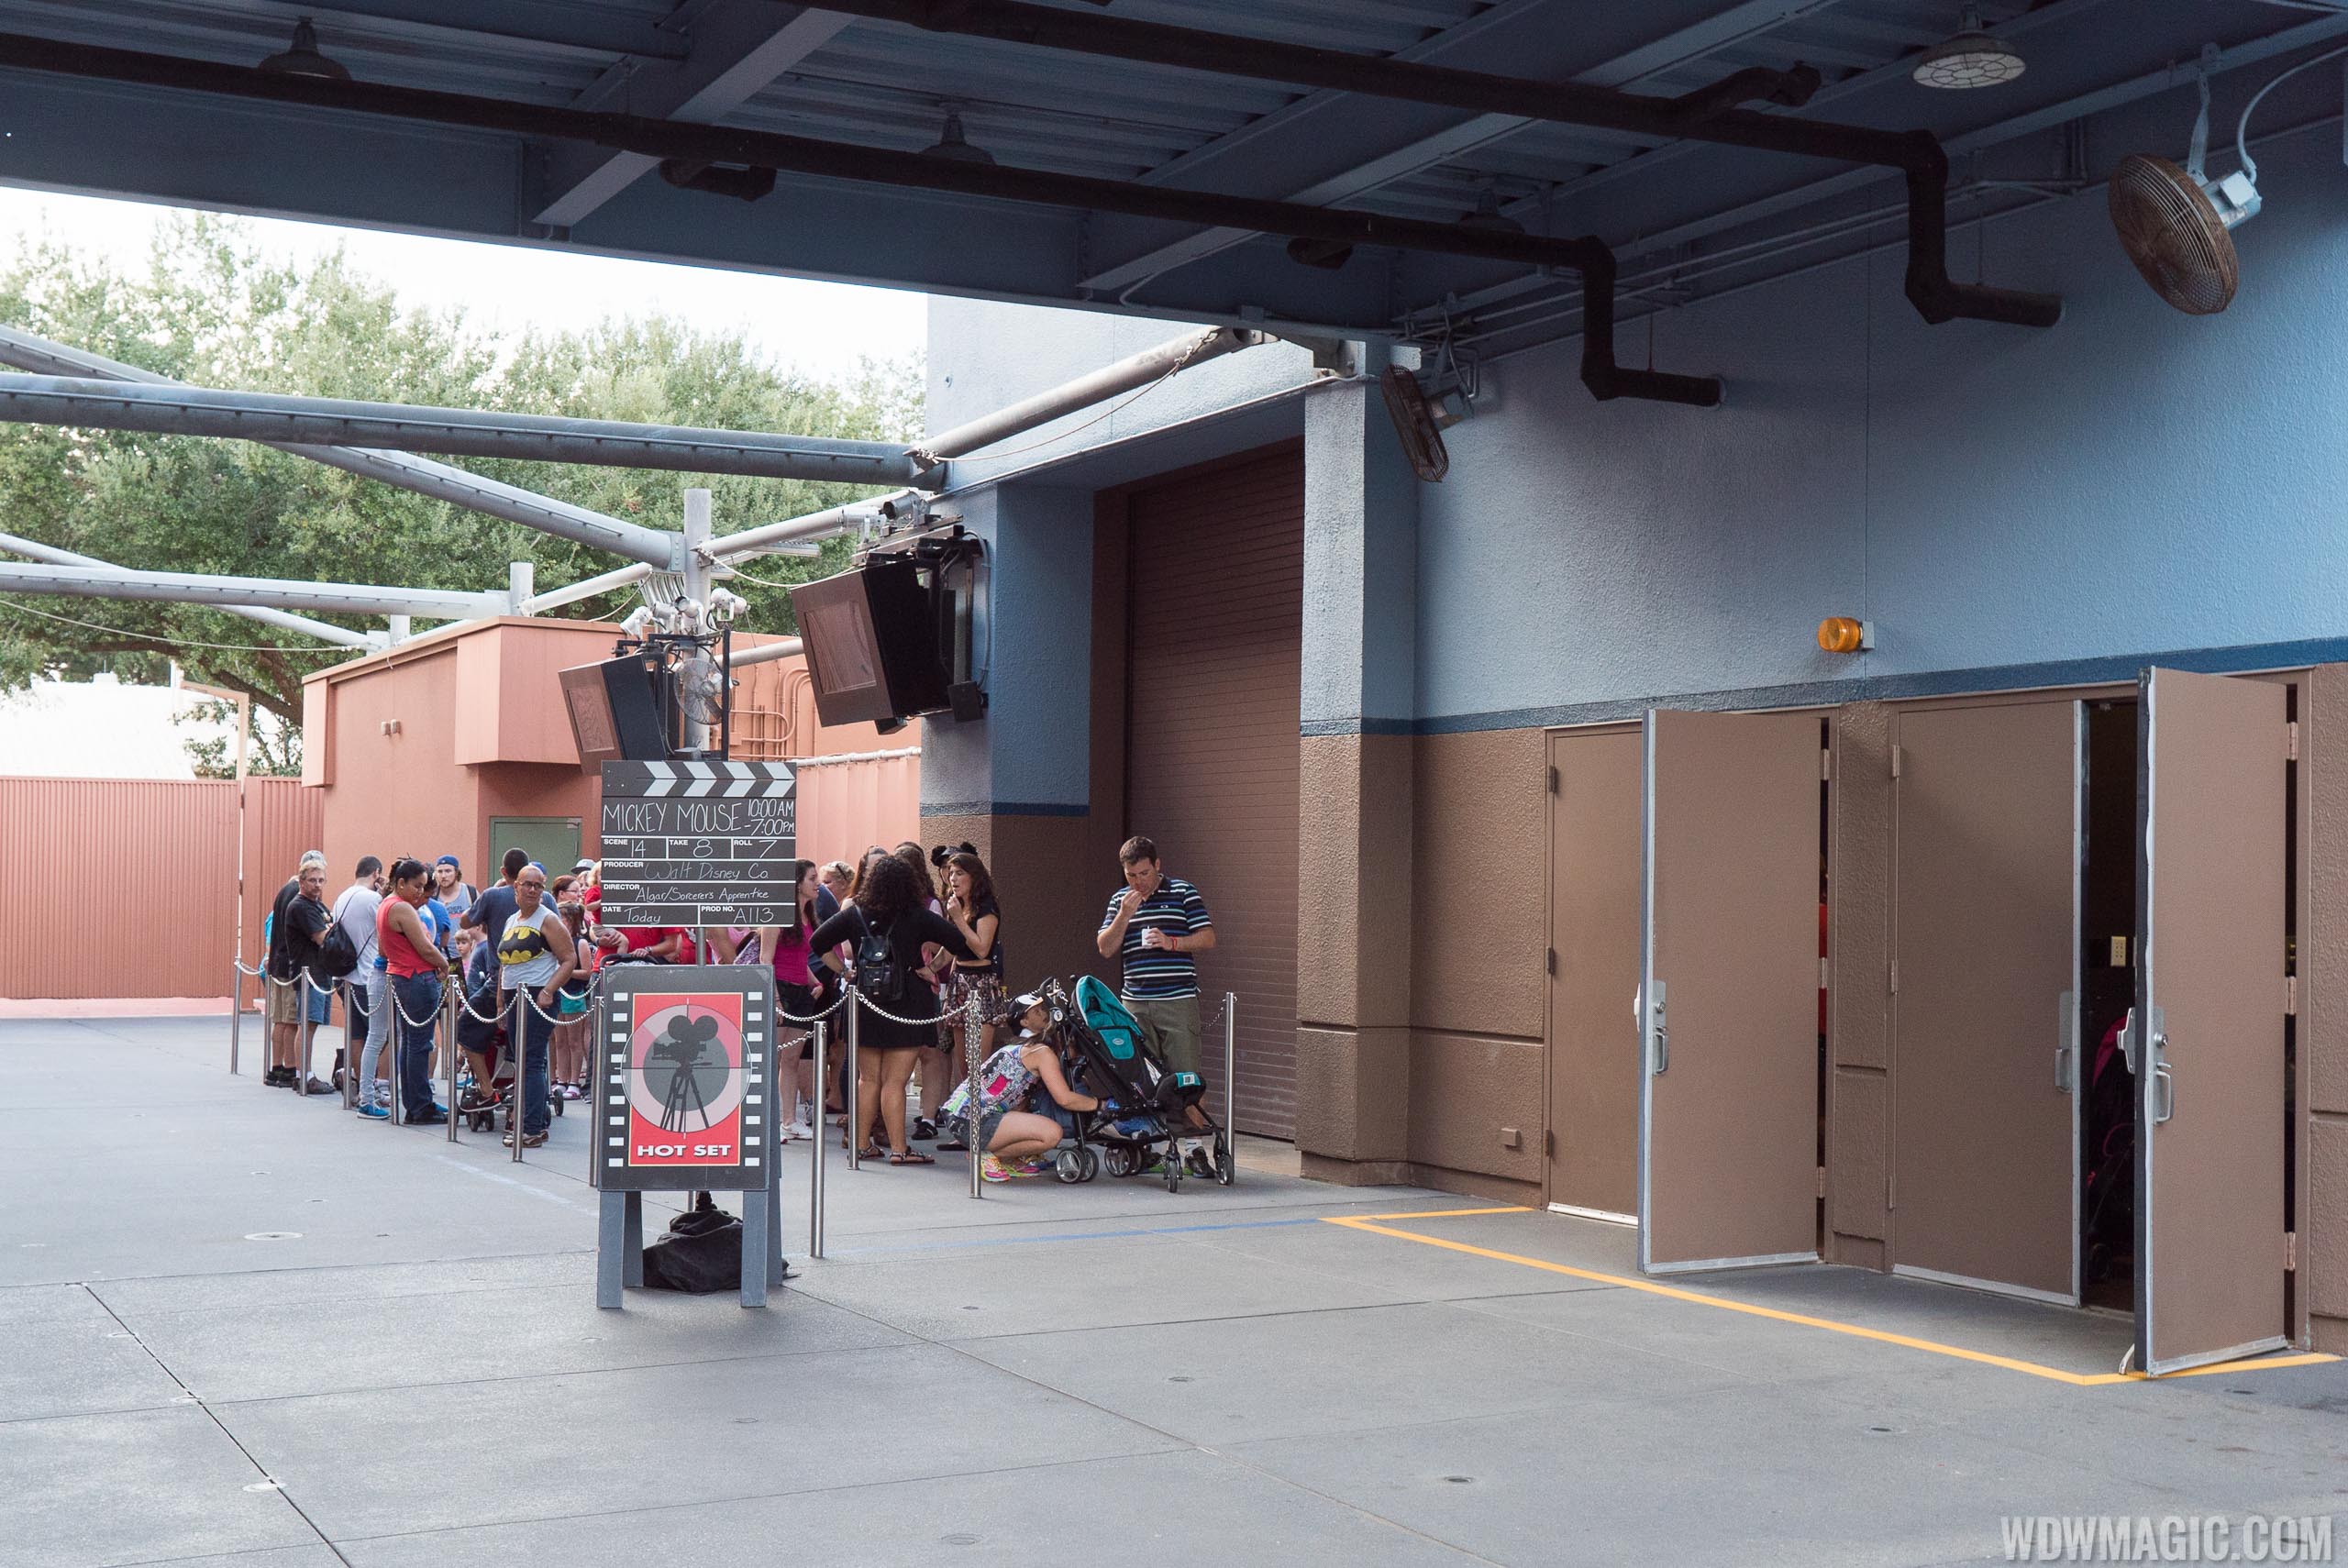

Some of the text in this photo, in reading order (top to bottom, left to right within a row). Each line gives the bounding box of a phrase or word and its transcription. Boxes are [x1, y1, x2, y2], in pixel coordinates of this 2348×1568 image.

[603, 802, 742, 833] MICKEY MOUSE
[631, 840, 646, 857] 14
[692, 839, 713, 858] 8
[759, 840, 777, 858] 7
[645, 862, 692, 880] Walt
[698, 863, 739, 881] Disney
[719, 888, 769, 902] Apprentice
[624, 907, 660, 924] Today
[734, 907, 774, 923] A113
[637, 1144, 732, 1157] HOT SET
